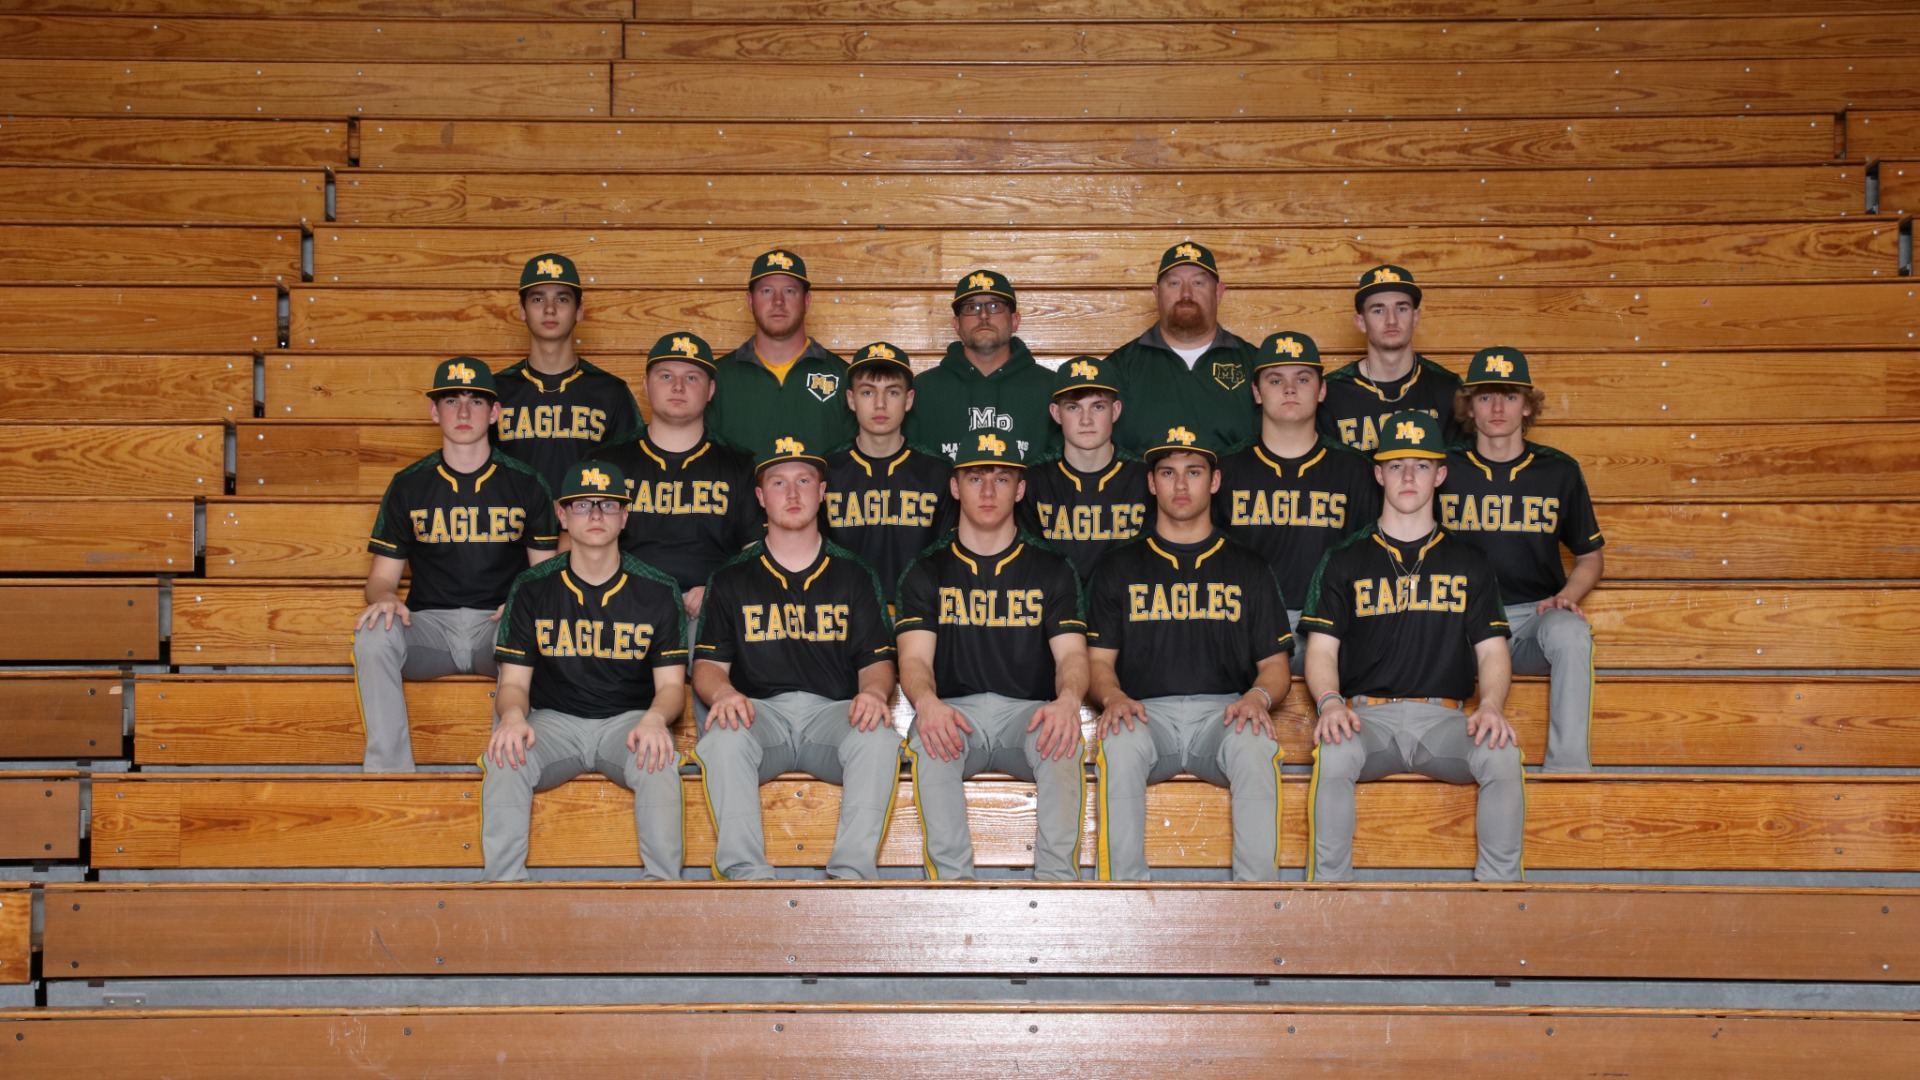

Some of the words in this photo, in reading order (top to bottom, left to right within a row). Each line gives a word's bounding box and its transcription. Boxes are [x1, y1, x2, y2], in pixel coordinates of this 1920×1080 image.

[498, 405, 606, 442] EAGLES
[410, 506, 526, 543] EAGLES
[824, 490, 938, 527] EAGLES
[1037, 501, 1146, 540] EAGLES
[1231, 490, 1347, 529] EAGLES
[1439, 494, 1559, 533] EAGLES
[939, 586, 1043, 627] EAGLES
[1128, 582, 1241, 622] EAGLES
[1354, 574, 1467, 617] EAGLES
[535, 619, 653, 659] EAGLES
[742, 604, 849, 642] EAGLES
